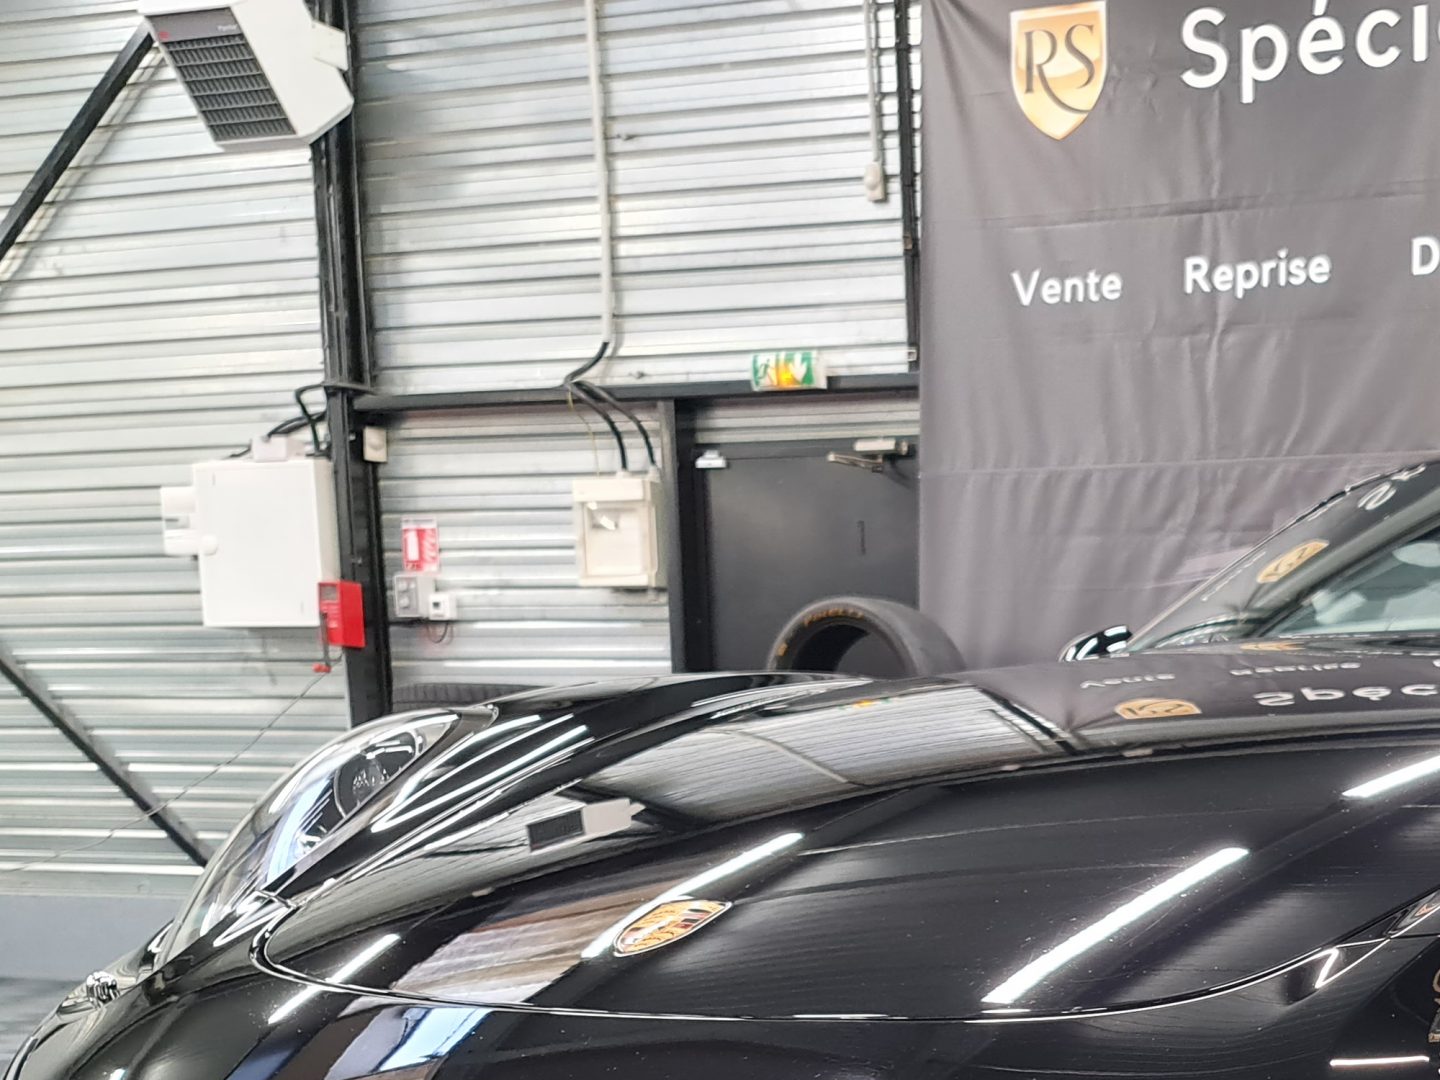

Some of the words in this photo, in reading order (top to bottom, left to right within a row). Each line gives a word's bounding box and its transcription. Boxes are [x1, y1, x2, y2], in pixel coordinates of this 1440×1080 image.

[1024, 23, 1093, 114] RS
[1011, 268, 1123, 306] Vente
[1183, 248, 1332, 299] Reprise
